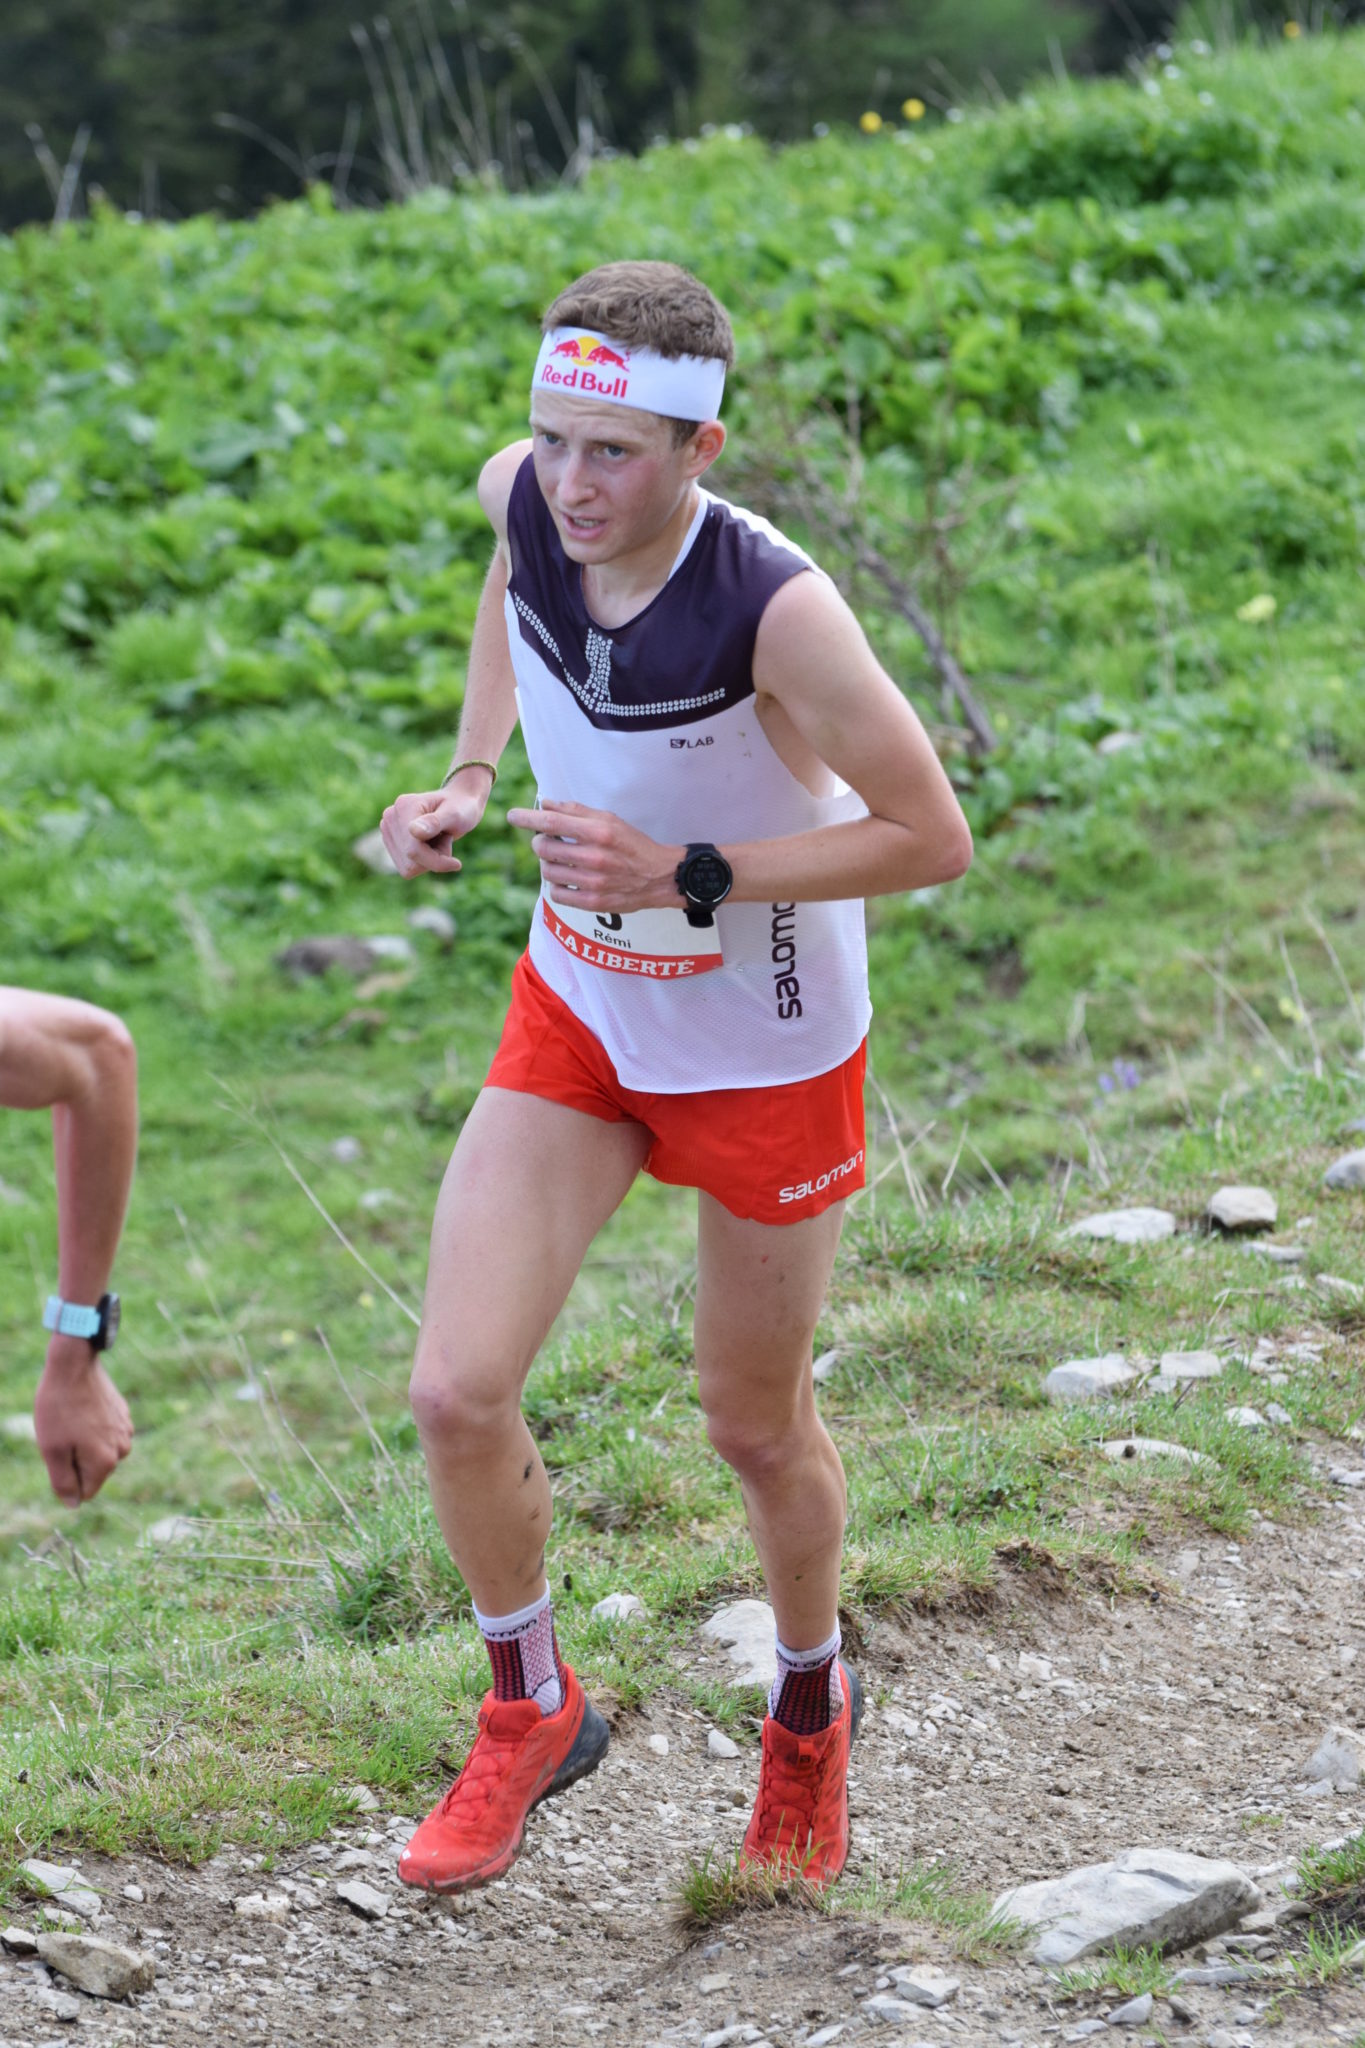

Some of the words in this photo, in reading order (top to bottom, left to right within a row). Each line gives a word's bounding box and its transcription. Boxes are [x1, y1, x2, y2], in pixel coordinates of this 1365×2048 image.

[541, 364, 578, 388] Red
[580, 371, 628, 398] Bull
[554, 921, 578, 953] LA
[581, 943, 695, 976] LIBERTÉ
[593, 928, 632, 949] Rémi
[771, 902, 803, 1019] salomo
